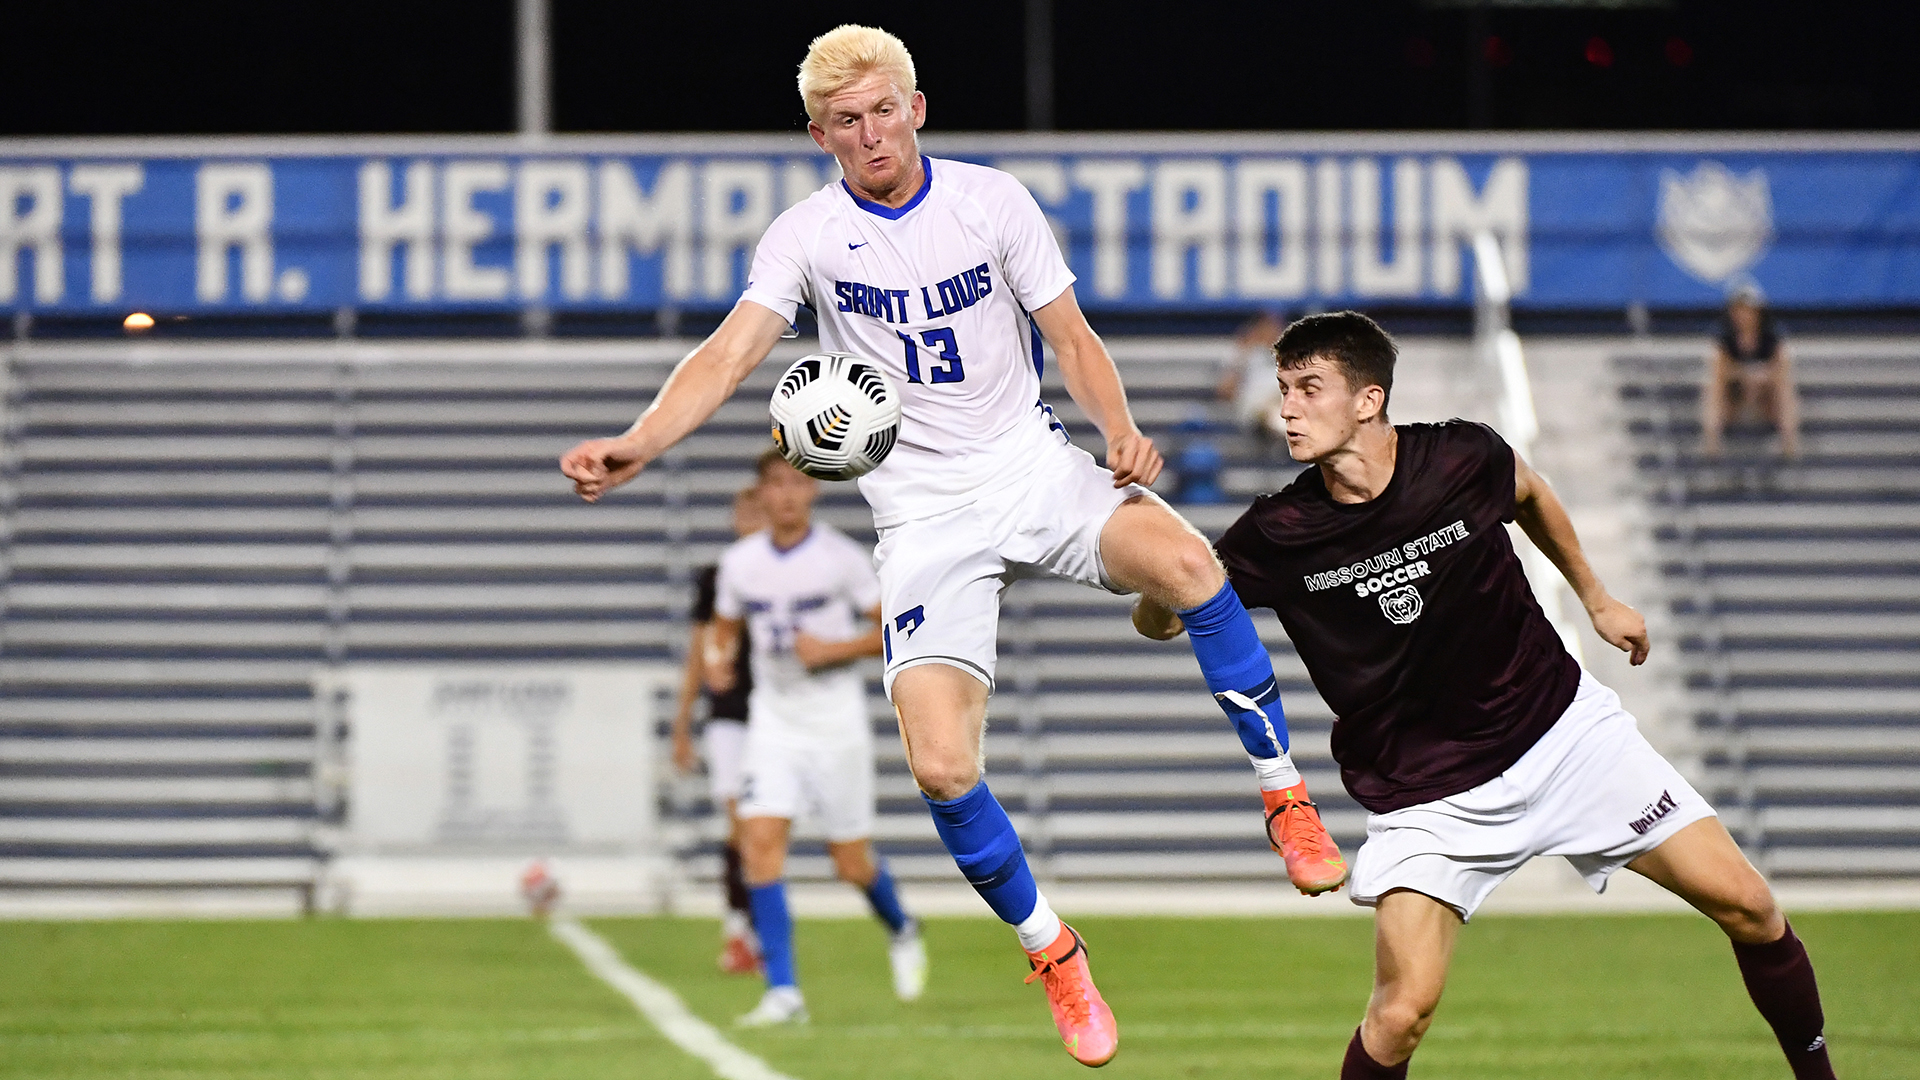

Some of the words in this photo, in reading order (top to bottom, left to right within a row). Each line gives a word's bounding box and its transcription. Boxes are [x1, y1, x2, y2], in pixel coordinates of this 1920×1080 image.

[196, 162, 309, 303] R.
[834, 279, 910, 324] SAINT
[920, 261, 993, 321] LOUIS
[896, 326, 966, 385] 13
[1303, 548, 1404, 592] MISSOURI
[1402, 519, 1470, 560] STATE
[1354, 560, 1432, 598] SOCCER
[1627, 788, 1677, 836] VALLEY
